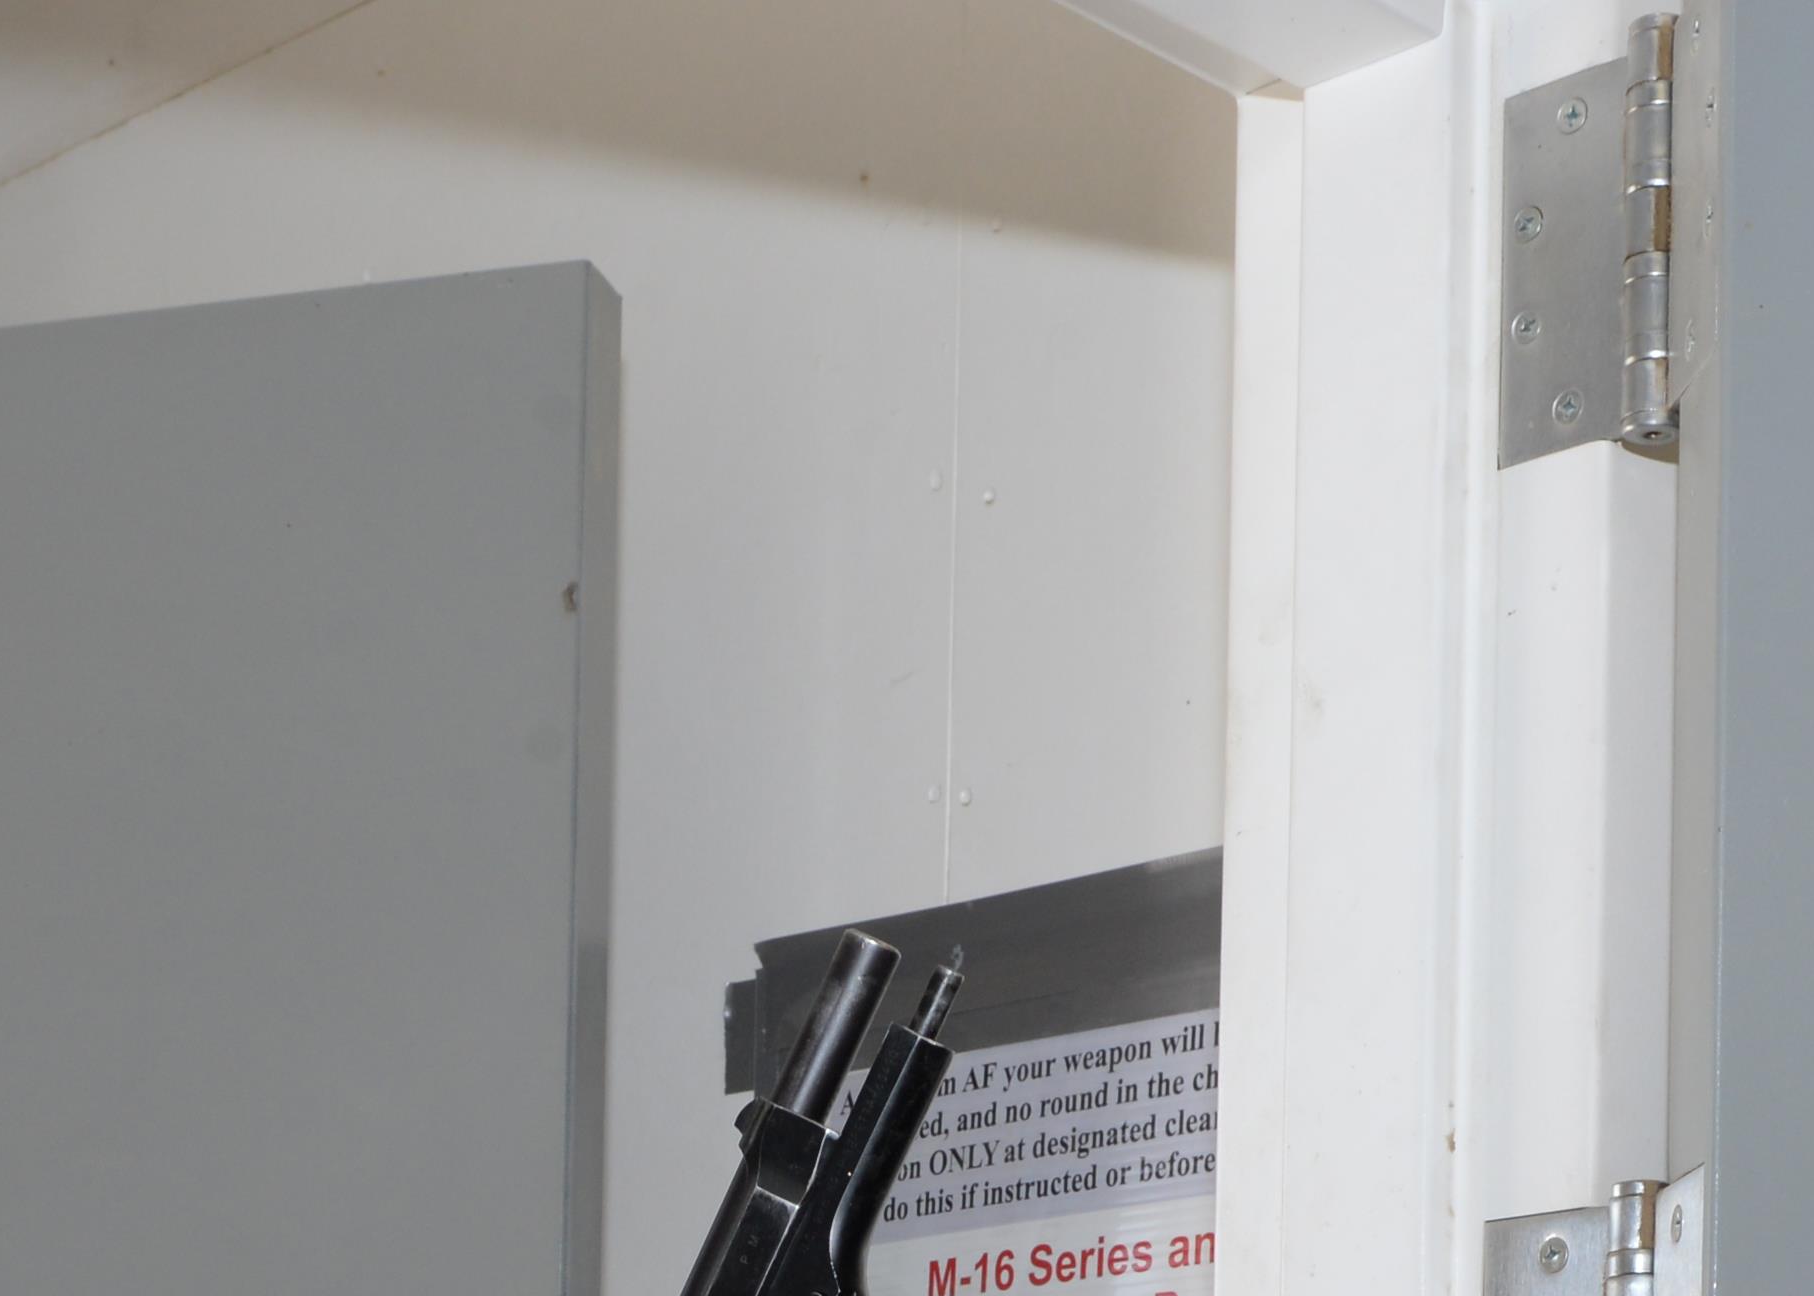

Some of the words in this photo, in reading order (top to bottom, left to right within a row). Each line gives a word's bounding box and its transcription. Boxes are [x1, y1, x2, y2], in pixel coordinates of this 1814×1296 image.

[963, 1062, 997, 1093] AF
[1002, 1058, 1056, 1091] your
[1064, 1040, 1151, 1073] weapon
[1161, 1024, 1205, 1055] will
[919, 1111, 949, 1139] ed,
[957, 1101, 996, 1132] and
[1005, 1101, 1032, 1124] no
[1040, 1082, 1108, 1117] round
[1117, 1079, 1138, 1104] in
[1148, 1072, 1184, 1099] the
[898, 1161, 921, 1181] on
[930, 1140, 1000, 1175] ONLY
[1004, 1139, 1025, 1163] at
[1033, 1114, 1156, 1159] designated
[883, 1197, 908, 1222] do
[916, 1189, 953, 1217] this
[961, 1182, 981, 1210] if
[983, 1164, 1097, 1206] instructed
[1106, 1165, 1131, 1187] or
[1139, 1151, 1216, 1182] before
[1028, 1236, 1152, 1286] Series
